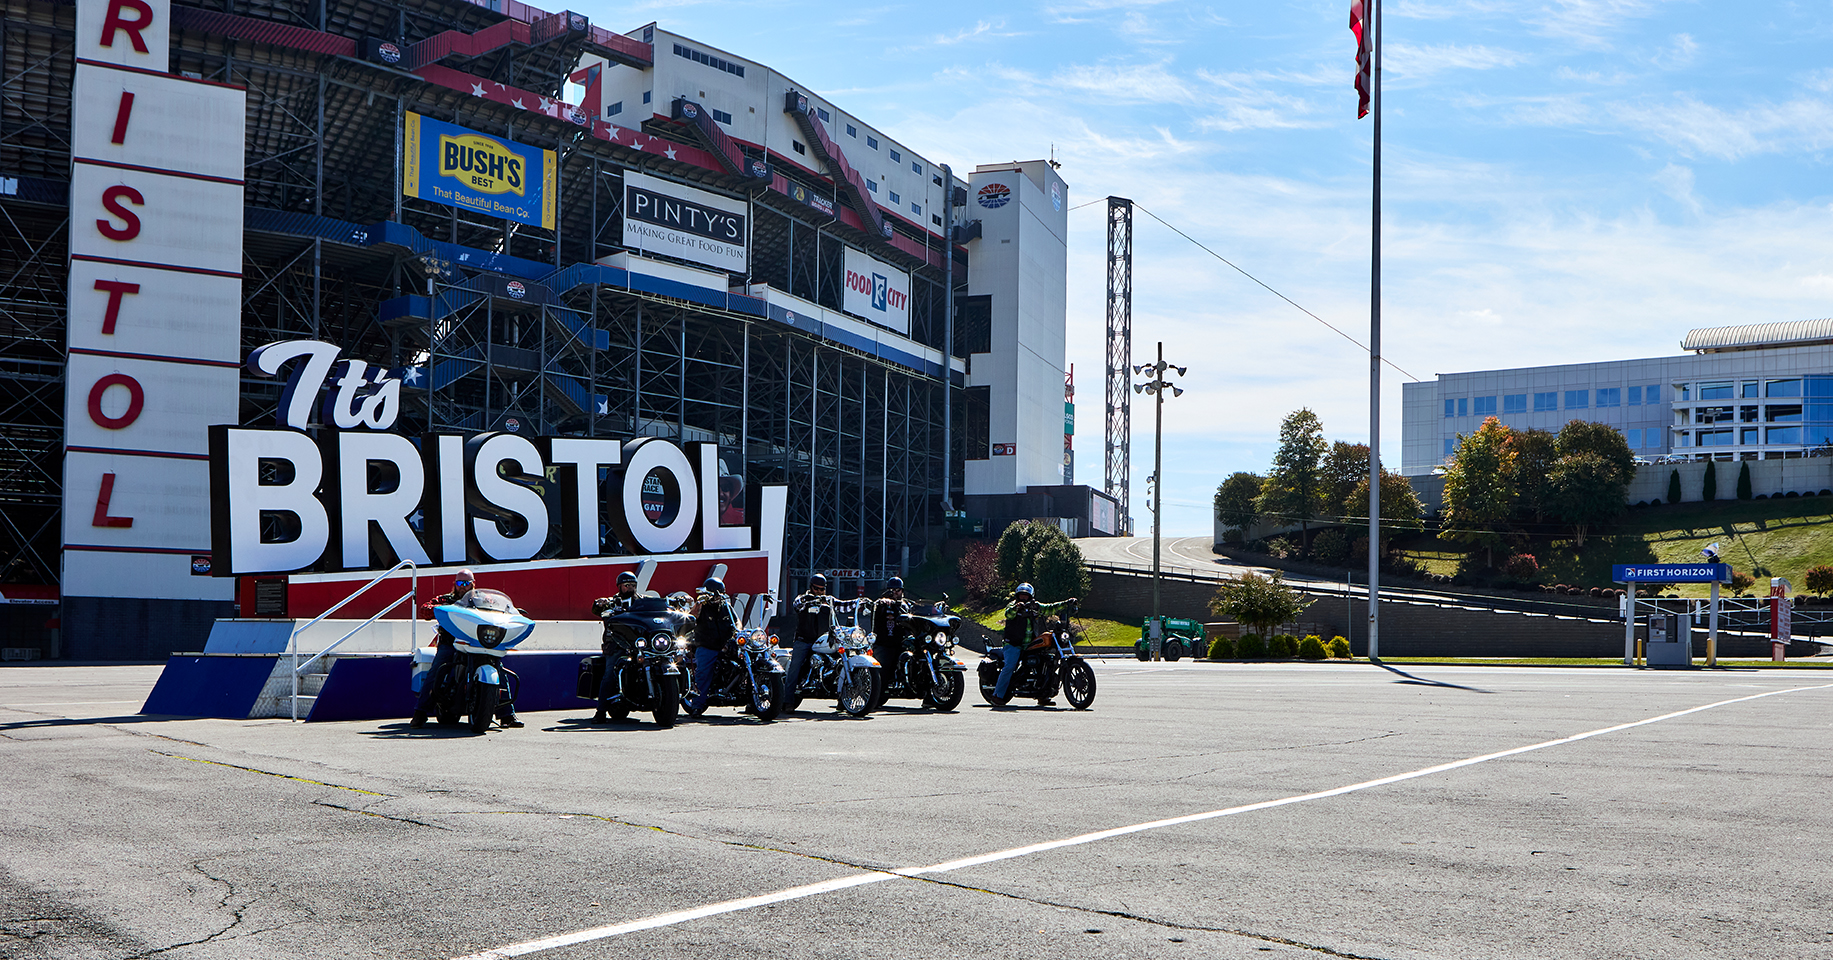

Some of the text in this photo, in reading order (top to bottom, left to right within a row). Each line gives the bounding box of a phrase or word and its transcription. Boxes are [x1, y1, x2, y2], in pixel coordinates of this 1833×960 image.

[444, 140, 521, 188] BUSH'S
[471, 175, 494, 189] BEST
[433, 186, 530, 219] That Beautiful Bean Co.
[635, 192, 738, 238] PINTY'S
[813, 194, 833, 209] TRACKER
[627, 223, 744, 259] MAKING GREAT FOOD FUN
[846, 269, 907, 311] FOOD CITY
[258, 340, 402, 431] It's
[1007, 447, 1014, 455] D
[227, 427, 752, 575] BRISTOL
[832, 569, 852, 577] GATE
[1637, 568, 1714, 577] FIRST HORIZON
